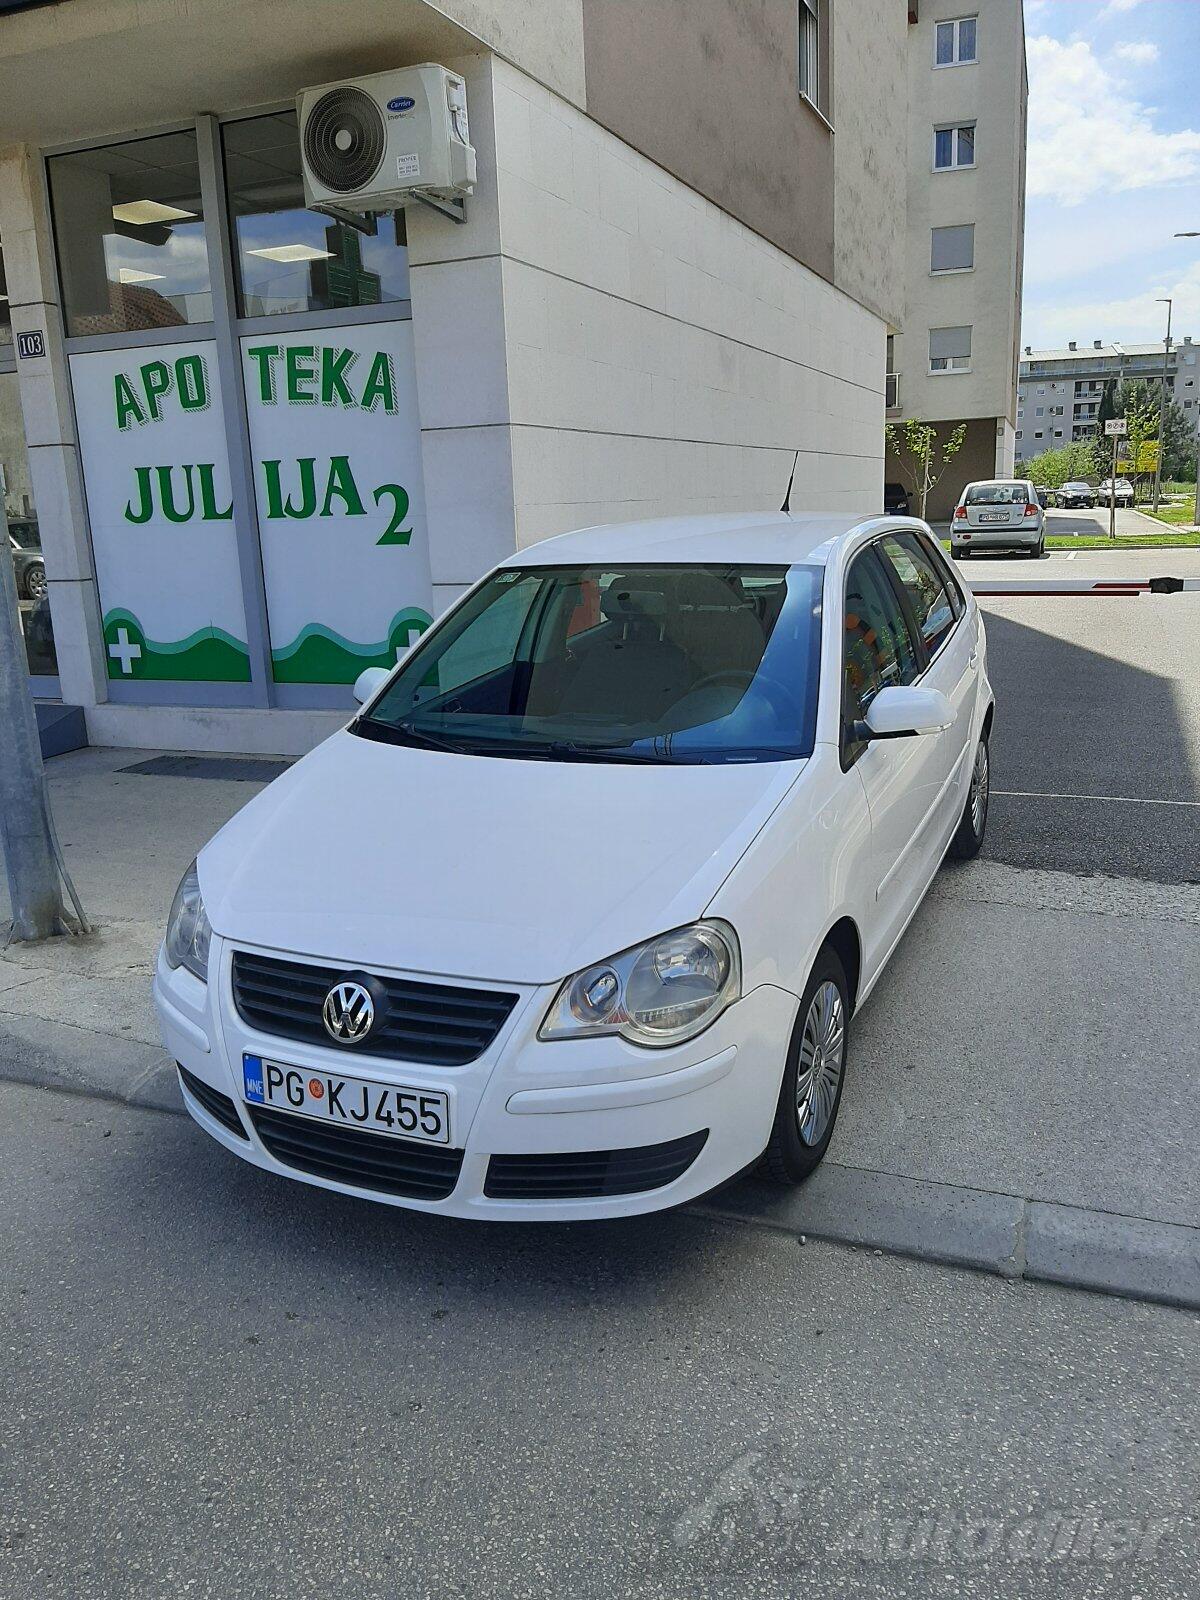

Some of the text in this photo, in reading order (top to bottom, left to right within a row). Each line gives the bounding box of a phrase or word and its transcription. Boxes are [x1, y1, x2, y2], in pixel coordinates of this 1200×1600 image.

[20, 335, 42, 355] 103
[372, 483, 414, 546] 2
[247, 1077, 264, 1096] MNE
[266, 1064, 442, 1136] PG KJ455
